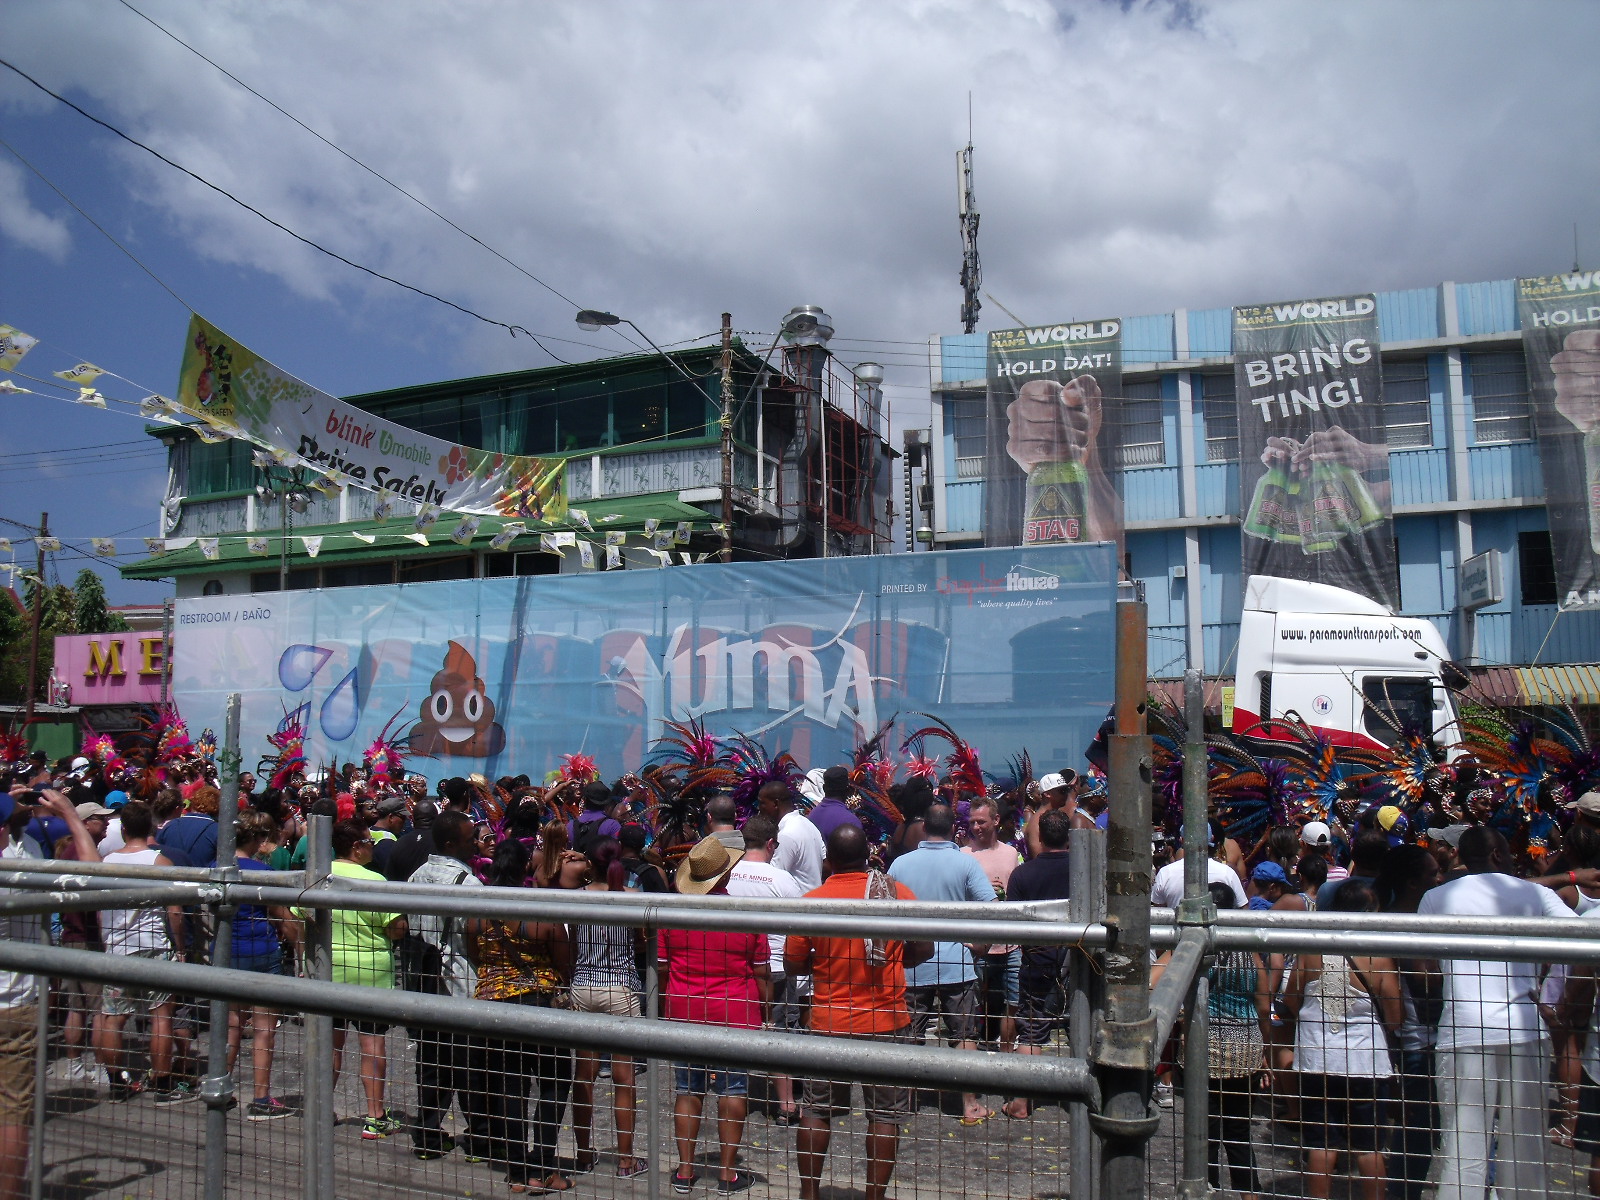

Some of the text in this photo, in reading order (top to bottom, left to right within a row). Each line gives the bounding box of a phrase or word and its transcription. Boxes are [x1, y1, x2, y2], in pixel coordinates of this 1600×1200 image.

[1236, 298, 1375, 322] IT'S A WORLD
[1237, 315, 1274, 325] MAN'S
[991, 321, 1119, 345] IT'S A WORLD
[992, 338, 1026, 348] MAN'S
[997, 353, 1112, 377] HOLD DAT!
[1244, 338, 1372, 388] BRING
[1251, 377, 1364, 423] TING!
[211, 408, 234, 417] SAFETY
[326, 409, 376, 449] blink
[297, 434, 448, 506] Drive Safely
[1026, 518, 1079, 541] STAG
[881, 584, 915, 594] PRINTED
[917, 583, 927, 593] BY
[1005, 598, 1034, 610] quality
[180, 611, 231, 625] RESTROOM
[242, 607, 271, 621] BAÑO
[748, 874, 773, 882] MINDS
